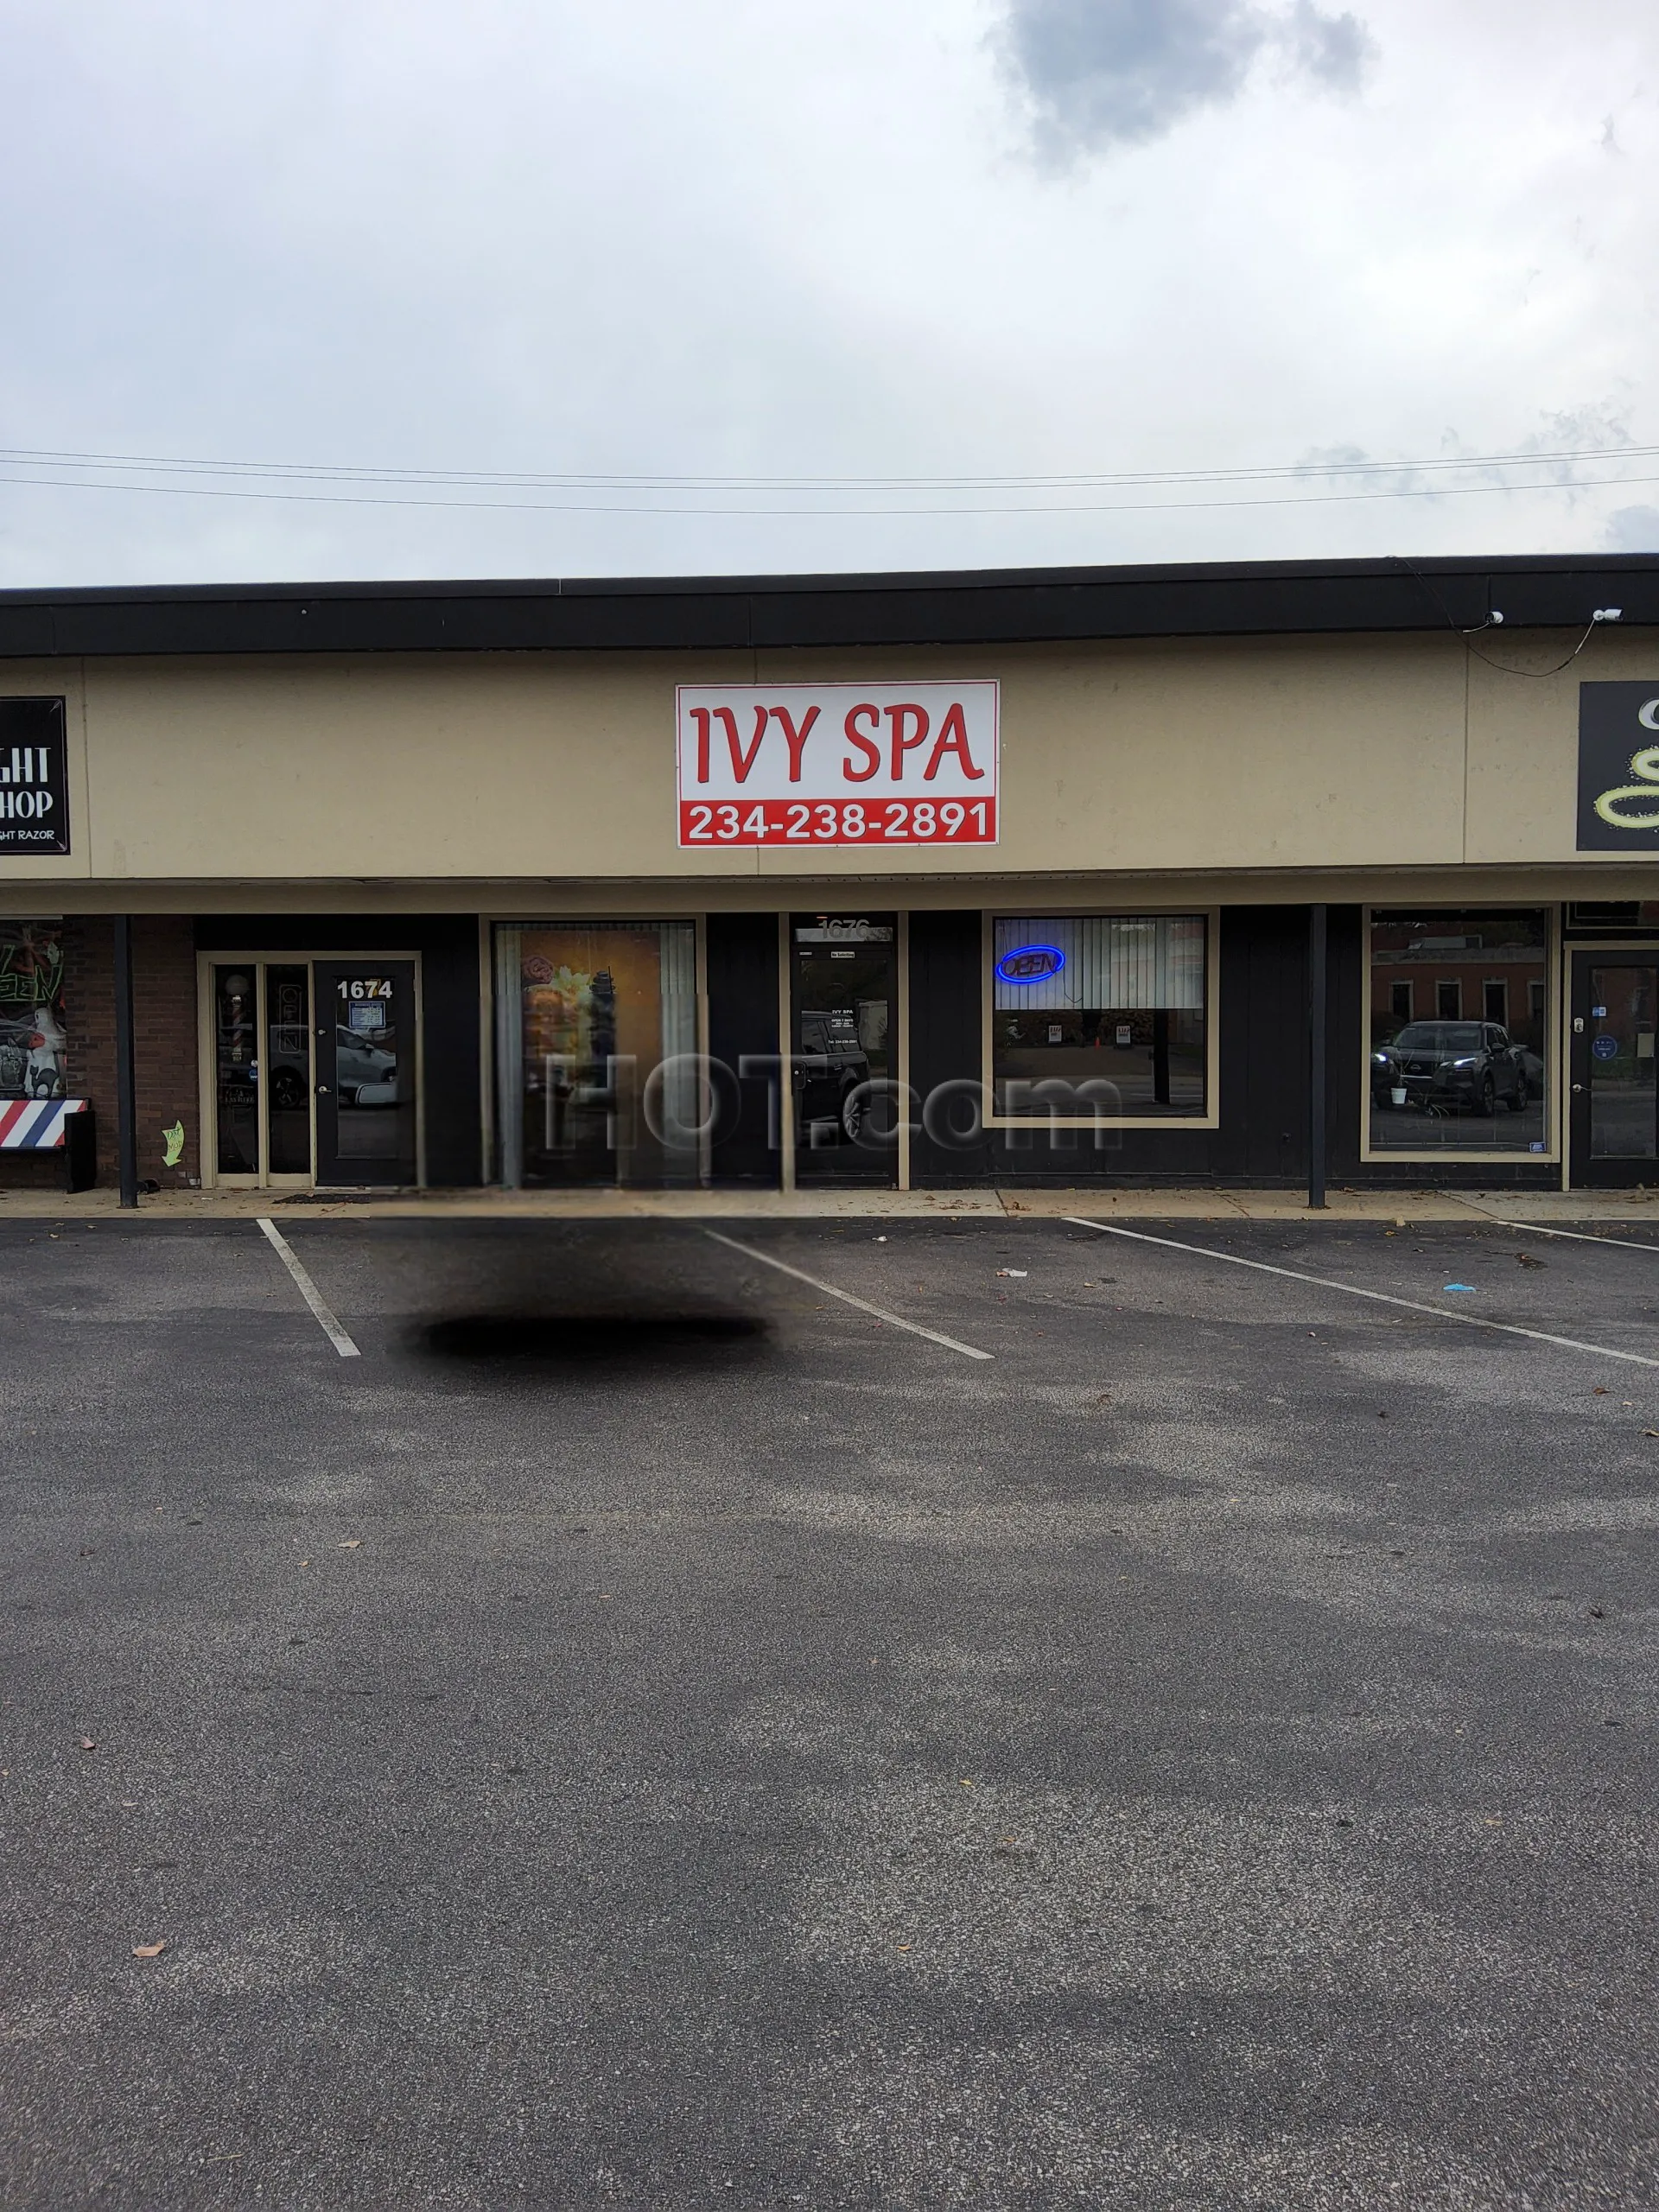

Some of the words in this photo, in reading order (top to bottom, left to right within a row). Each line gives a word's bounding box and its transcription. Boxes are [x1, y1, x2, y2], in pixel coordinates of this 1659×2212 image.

[689, 705, 822, 784] IVY
[842, 702, 985, 783] SPA
[689, 802, 987, 840] 234-238-2891
[17, 830, 55, 840] RAZOR
[818, 918, 870, 938] 1676
[337, 981, 393, 999] 1674
